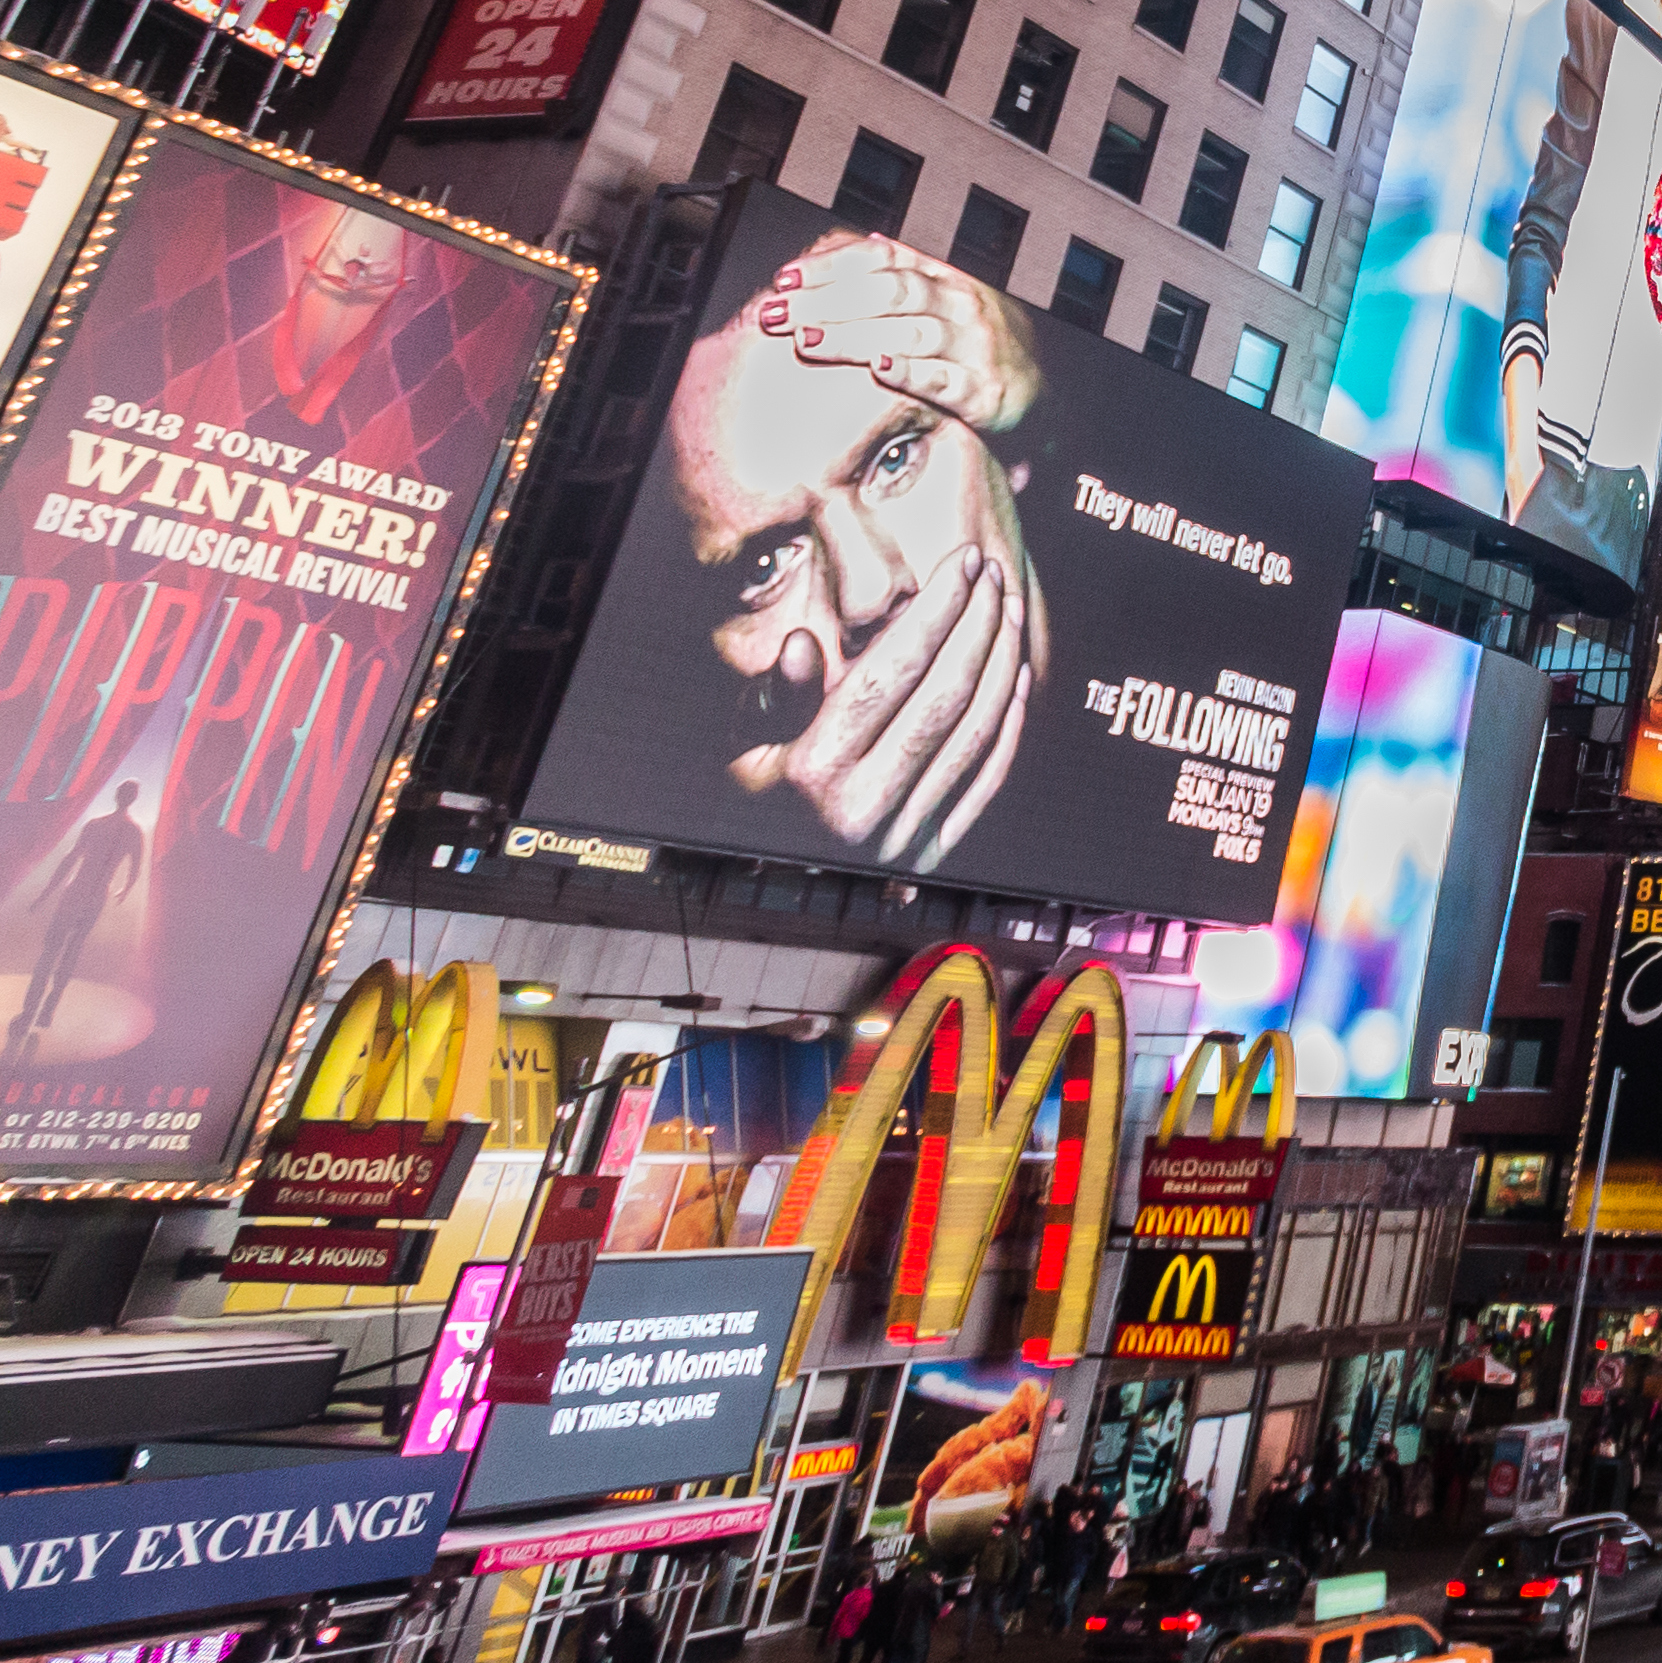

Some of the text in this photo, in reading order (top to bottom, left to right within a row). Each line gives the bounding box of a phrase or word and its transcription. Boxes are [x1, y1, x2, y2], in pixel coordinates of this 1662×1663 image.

[464, 27, 556, 71] 24
[424, 74, 570, 106] HOURS
[84, 394, 450, 513] 2013 TONY AWARD
[66, 429, 438, 569] WINNER!
[1074, 473, 1294, 586] They will never let go.
[32, 492, 411, 613] BEST MUSICAL REVIVAL
[1215, 669, 1297, 715] KEVIN BACON
[1084, 676, 1291, 773] THE FOLLOWING
[1173, 774, 1273, 819] SUN JAN 19
[1179, 758, 1277, 793] SPECIAL PREVIEW
[1168, 800, 1242, 835] MONDAYS
[1213, 832, 1262, 864] FOX 5
[1635, 878, 1654, 901] 8
[5, 1109, 202, 1130] or 212-239-6200
[146, 1134, 192, 1151] AVES.
[263, 1152, 433, 1185] McDonald's
[1145, 1156, 1274, 1179] McDonald's
[1162, 1180, 1249, 1195] Restaurant
[275, 1185, 393, 1208] Restaurant
[230, 1245, 390, 1268] OPEN 24 HOURS
[519, 1238, 599, 1284] JERSEY
[514, 1280, 578, 1327] BOYS
[619, 1313, 721, 1344] EXPERIENCE
[721, 1310, 759, 1335] THE
[552, 1343, 768, 1397] idnight Moment
[549, 1391, 720, 1435] IN TIMES SQUARE
[121, 1491, 436, 1576] EXCHANGE
[502, 1542, 539, 1562] TIMES
[539, 1535, 590, 1559] SQUARE
[589, 1527, 645, 1549] MUSEUM
[644, 1522, 670, 1541] AND
[711, 1508, 755, 1531] CENTER
